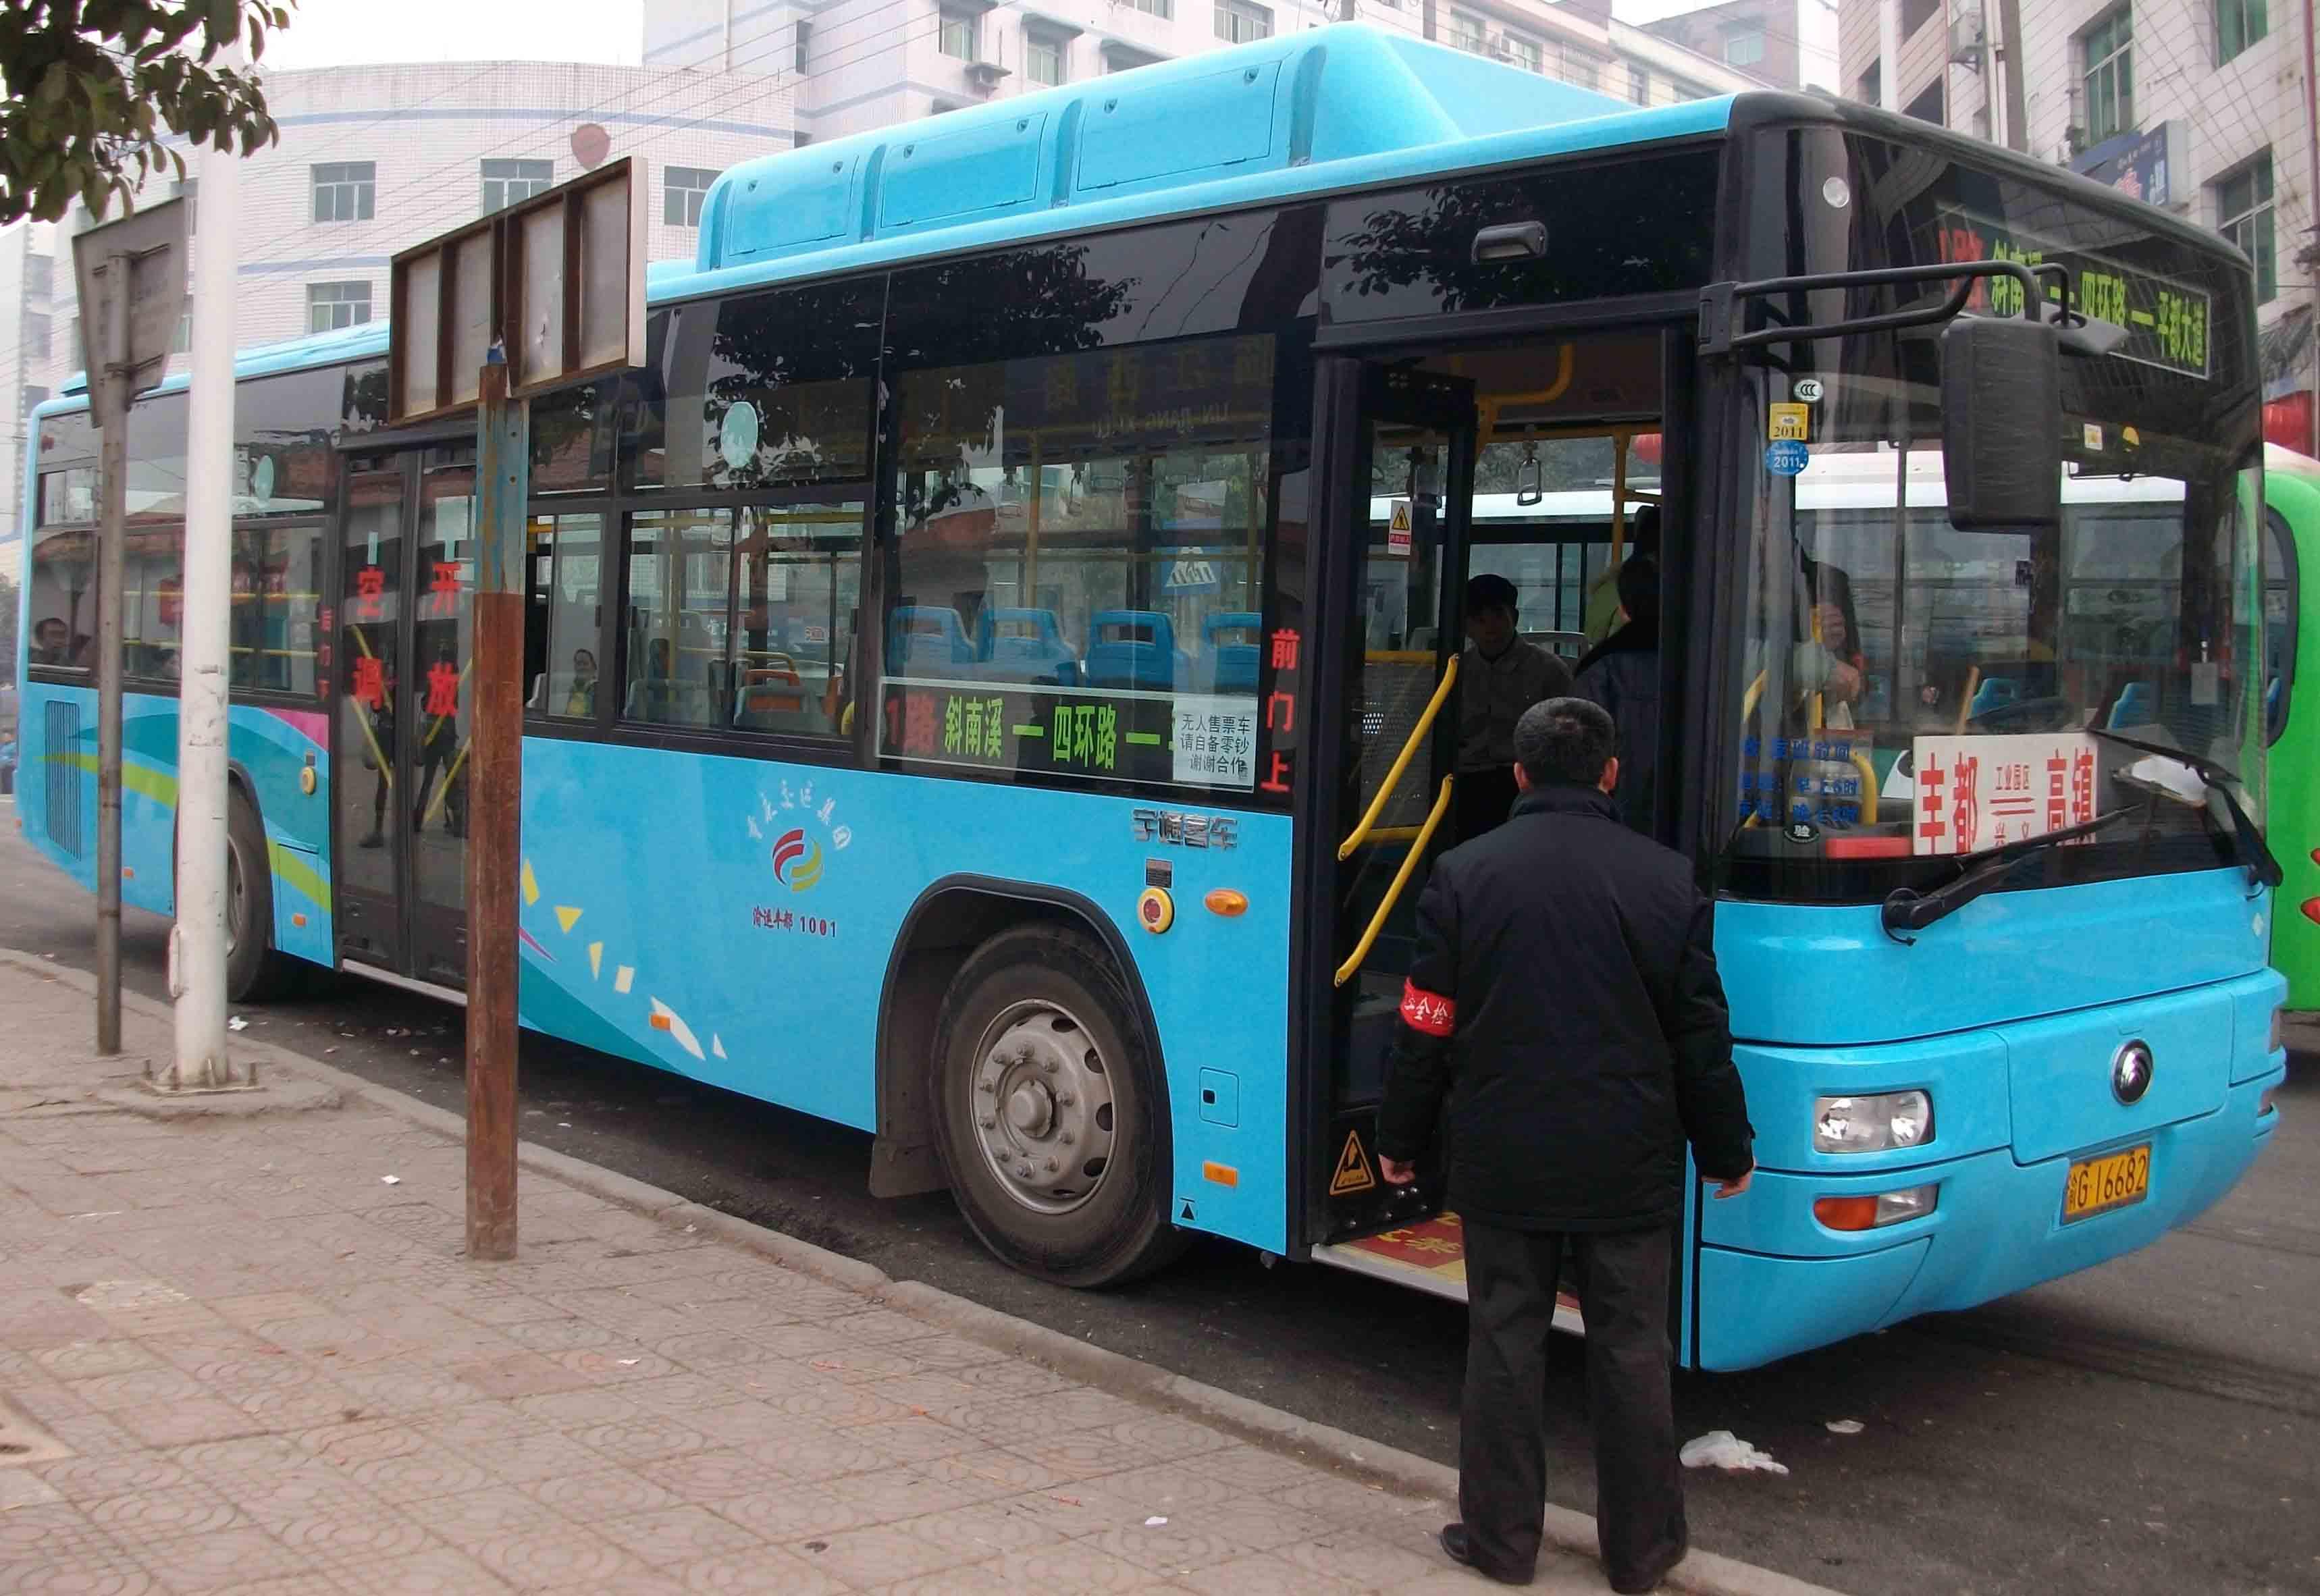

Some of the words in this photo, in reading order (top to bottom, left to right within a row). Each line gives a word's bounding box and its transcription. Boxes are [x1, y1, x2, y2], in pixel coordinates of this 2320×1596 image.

[1773, 426, 1804, 437] 2011
[1774, 456, 1799, 467] 2011
[1260, 628, 1300, 793] 前门上
[1182, 713, 1251, 735] 无人售票车
[1180, 734, 1250, 755] 请自备零钞
[1189, 753, 1248, 775] 谢谢合作
[1995, 764, 2030, 791] 工业园区
[1919, 752, 1977, 854] 丰都
[1132, 808, 1238, 850] 宇通客车
[800, 915, 837, 938] 1001
